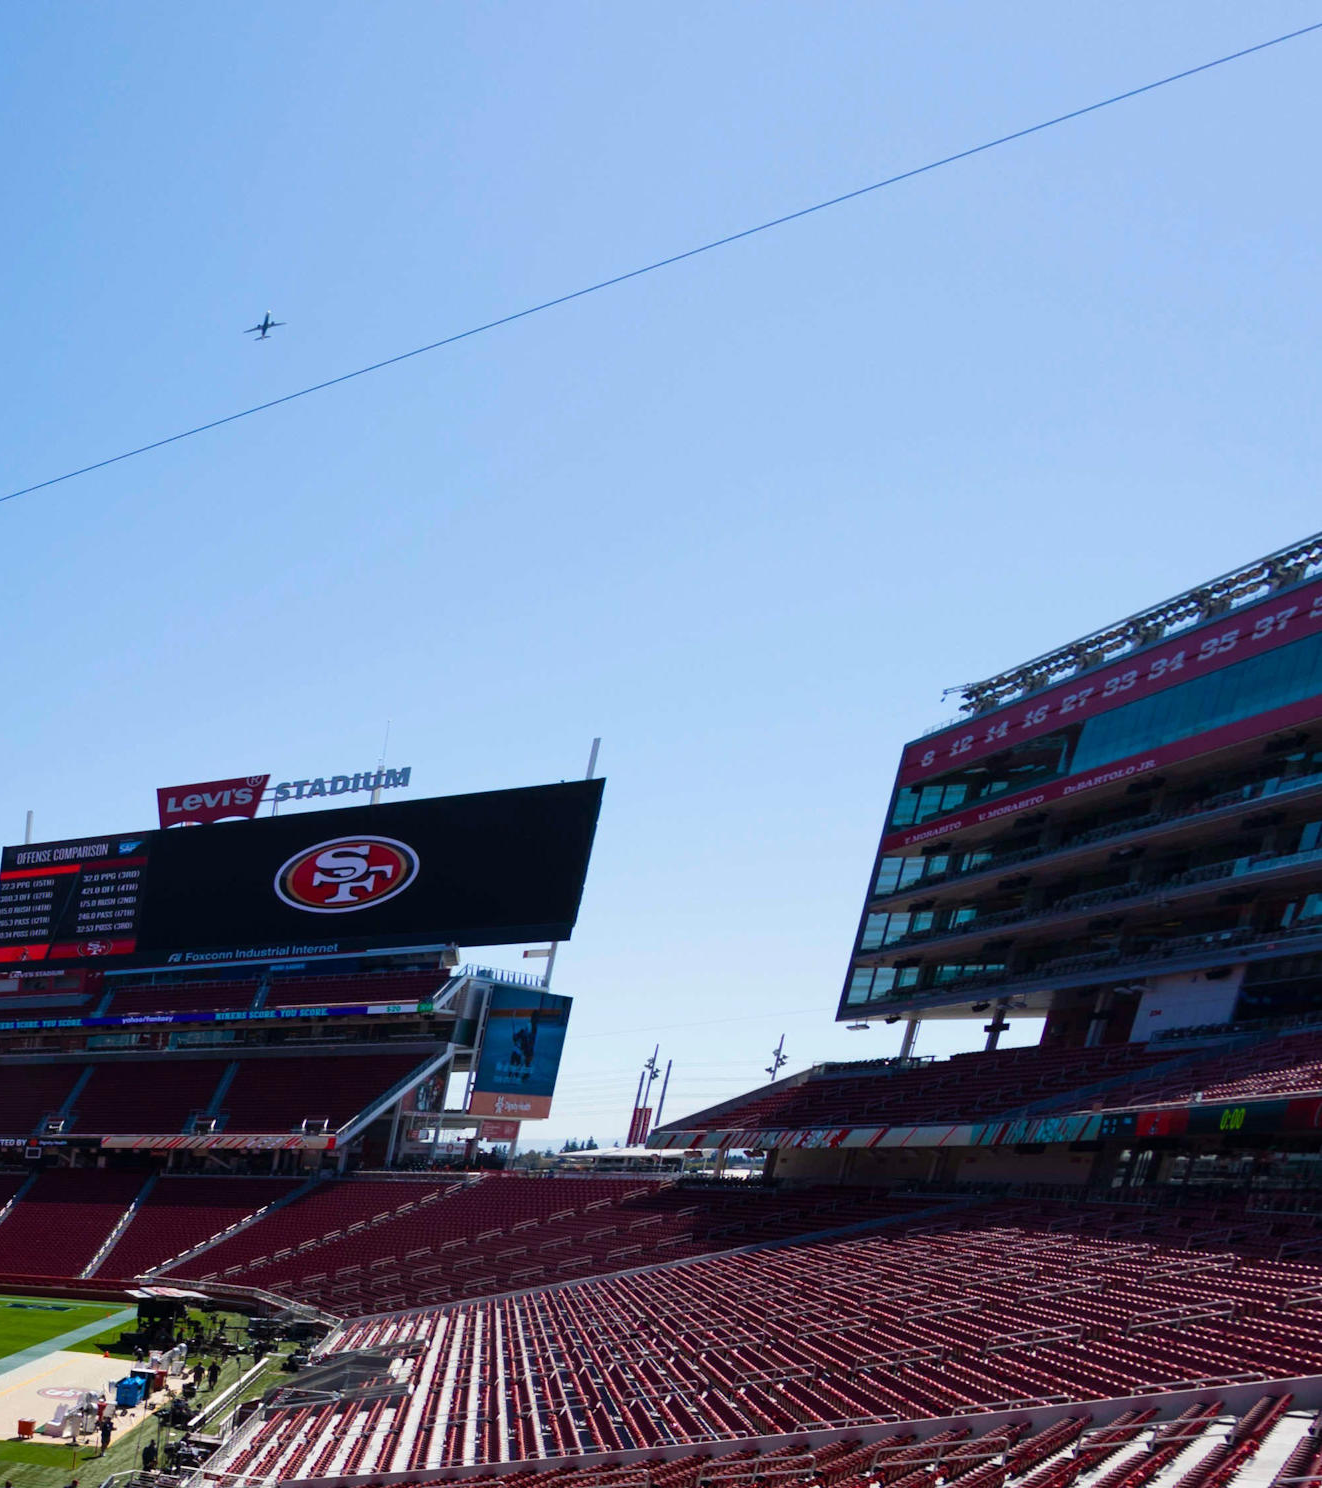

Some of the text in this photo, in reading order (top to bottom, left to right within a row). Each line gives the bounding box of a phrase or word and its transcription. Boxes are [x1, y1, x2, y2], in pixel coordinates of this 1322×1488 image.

[921, 750, 935, 767] 8
[949, 735, 974, 757] 12
[984, 720, 1009, 743] 14
[1022, 704, 1050, 729] 16
[1059, 687, 1094, 714] 27
[1147, 651, 1186, 681] 34
[1197, 629, 1240, 661] 35
[1251, 606, 1298, 640] 37
[275, 766, 412, 802] STADIUM
[987, 794, 1044, 819] MORABITO
[912, 820, 962, 843] MORABITO
[16, 843, 109, 866] OFFENSE COMPARISON
[312, 844, 394, 903] SF
[185, 943, 338, 962] Foxconn Industrial Internet
[122, 1014, 174, 1024] yahoo/fantasy
[215, 1011, 247, 1021] NINERS
[281, 1008, 297, 1018] YOU
[1219, 1108, 1246, 1131] 0:00
[16, 1138, 28, 1146] BY
